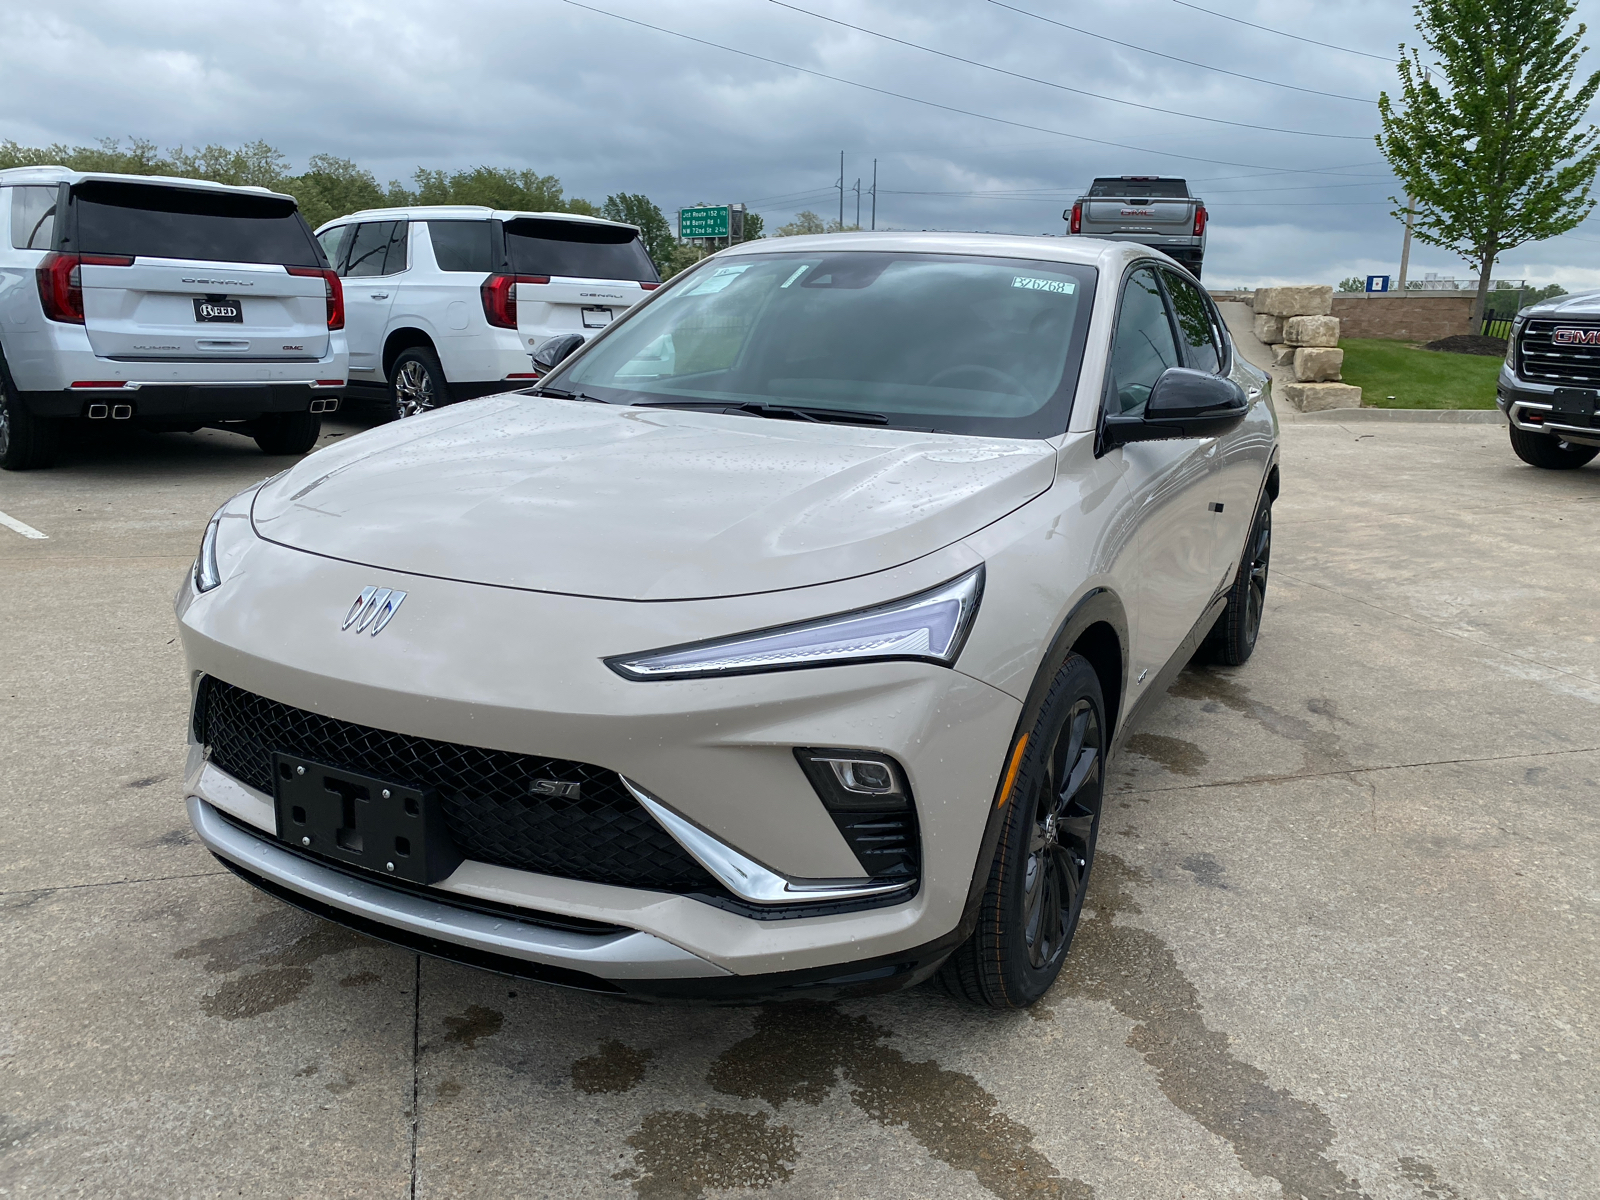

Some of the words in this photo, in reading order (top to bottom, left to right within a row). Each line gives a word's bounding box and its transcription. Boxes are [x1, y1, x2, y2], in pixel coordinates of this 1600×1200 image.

[181, 278, 254, 286] DENALI
[200, 304, 236, 318] REED
[1556, 330, 1600, 344] GM
